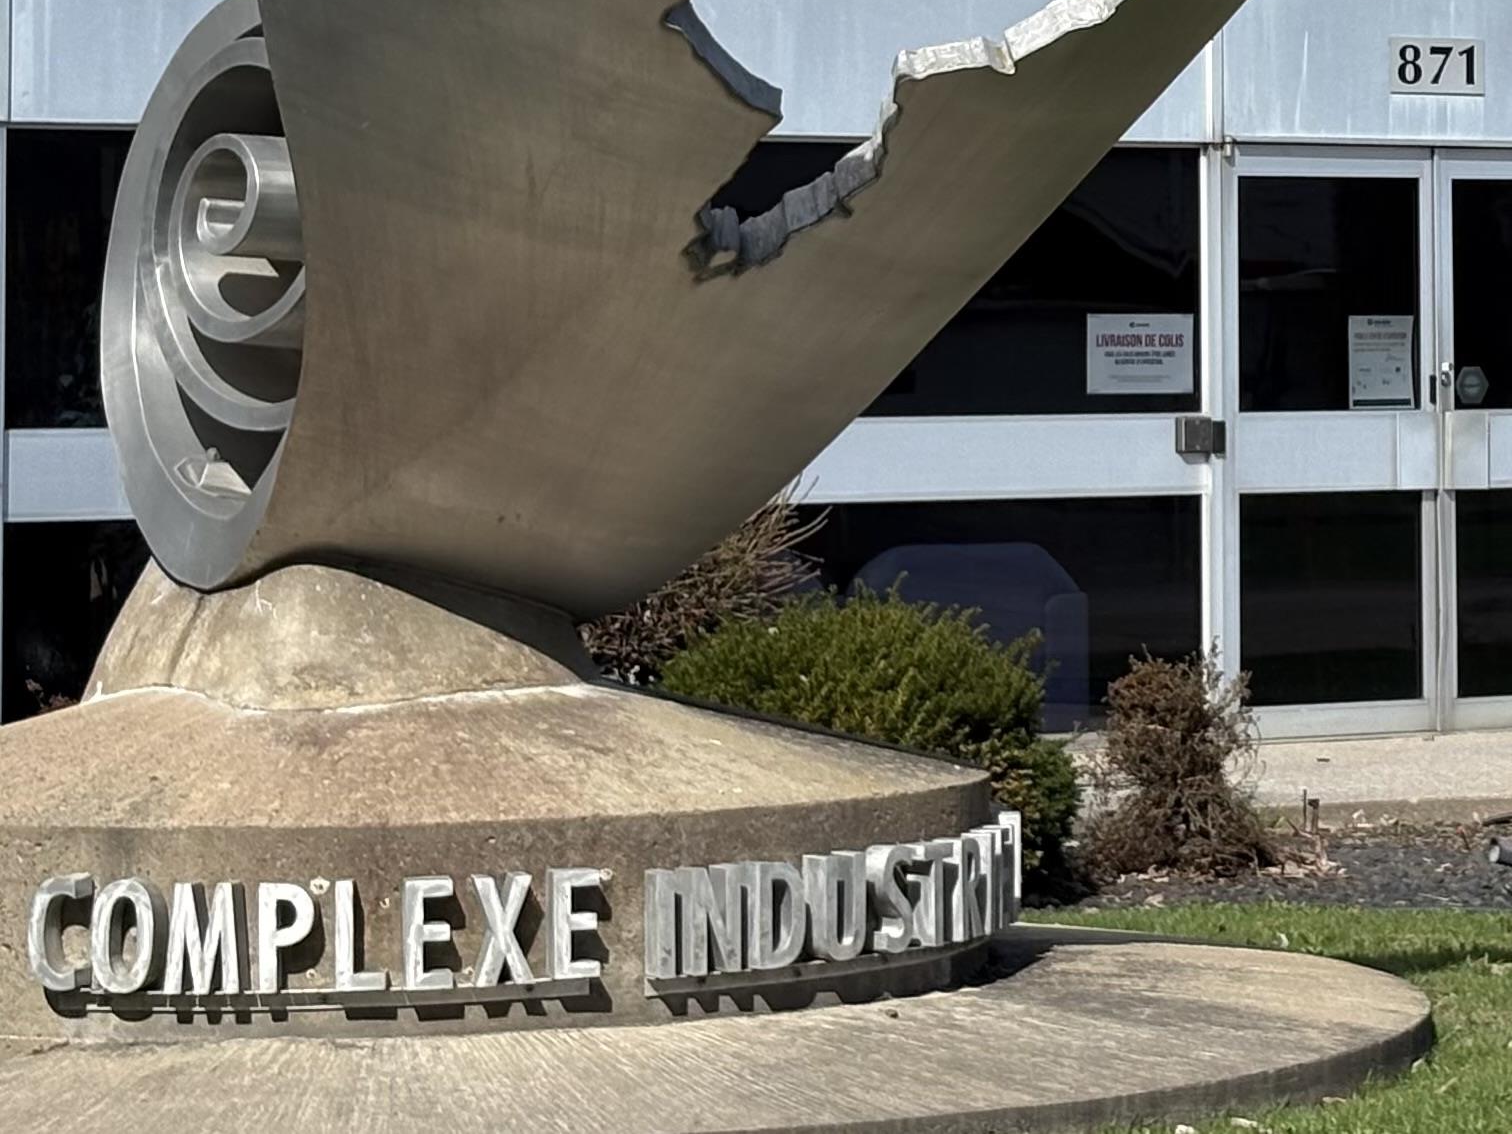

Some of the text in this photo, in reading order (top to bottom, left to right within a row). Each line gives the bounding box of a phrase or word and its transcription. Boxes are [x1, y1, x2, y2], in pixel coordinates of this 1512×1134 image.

[1398, 44, 1475, 85] 871
[1096, 333, 1185, 348] LIVRAISON DE COLIS
[27, 870, 602, 994] COMPLEXE
